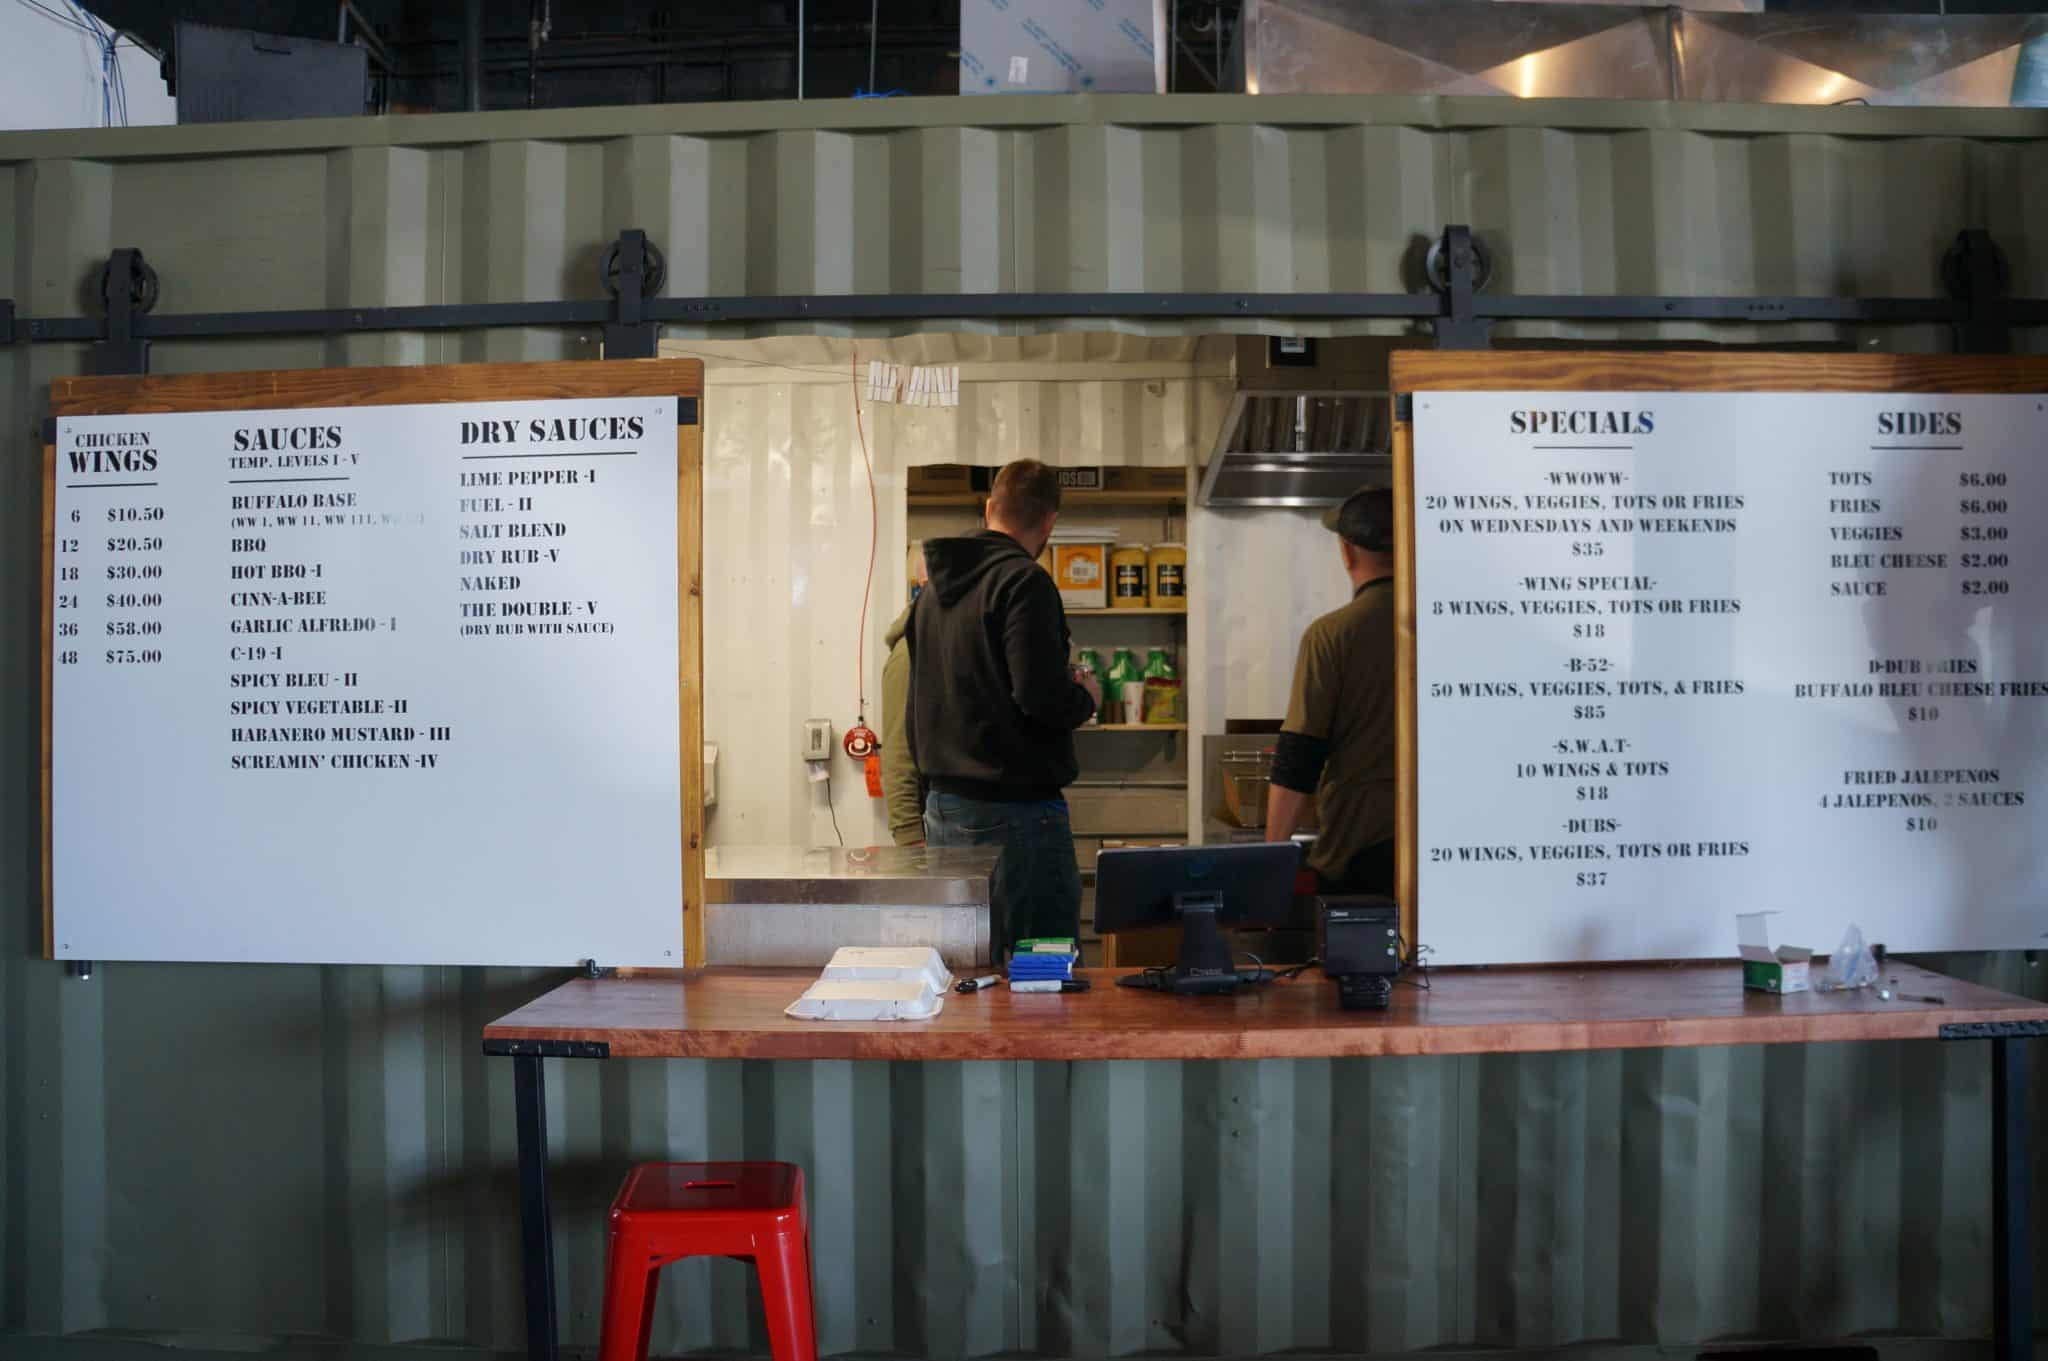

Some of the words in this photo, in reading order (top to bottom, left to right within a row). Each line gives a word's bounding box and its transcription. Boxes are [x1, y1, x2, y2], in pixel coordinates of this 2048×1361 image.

[460, 420, 520, 444] DRY
[530, 416, 644, 442] SAUCES
[1510, 411, 1654, 434] SPECIALS
[1878, 412, 1962, 435] SIDES
[75, 432, 151, 448] CHICKEN
[233, 426, 342, 451] SAUCES
[69, 449, 158, 473] WINGS
[229, 456, 273, 469] TEMP.
[278, 455, 328, 468] LEVELS
[332, 454, 338, 466] I
[350, 453, 359, 465] V
[461, 472, 502, 487] LIME
[509, 470, 578, 485] PEPPER
[1544, 471, 1628, 486] -WWOWW-
[1828, 472, 1872, 485] TOTS
[1960, 473, 2006, 487] $6.00
[232, 494, 307, 509] BUFFALO
[313, 493, 357, 507] BASE
[460, 498, 504, 512] FUEL
[519, 497, 532, 511] II
[1426, 496, 1447, 509] 20
[1612, 495, 1657, 509] TOTS
[1662, 495, 1687, 509] OR
[1693, 495, 1744, 509] FRIES
[1830, 499, 1880, 513] FRIES
[1960, 499, 2007, 513] $6.00
[71, 509, 80, 522] 6
[108, 507, 164, 522] $10.50
[232, 517, 256, 528] (WW
[277, 516, 296, 526] WW
[325, 515, 344, 525] WW
[459, 524, 503, 539] SALT
[508, 522, 566, 537] BLEND
[1439, 520, 1464, 533] ON
[1471, 519, 1591, 533] WEDNESDAYS
[1597, 519, 1634, 533] AND
[1639, 518, 1736, 533] WEEKENDS
[1830, 527, 1903, 541] VEGGIES
[1961, 527, 2008, 541] $3.00
[61, 539, 79, 552] 12
[107, 538, 162, 552] $20.50
[231, 538, 266, 553] BBQ
[1572, 542, 1603, 556] $35
[460, 550, 495, 565] DRY
[501, 550, 539, 564] RUB
[1831, 555, 1875, 568] BLEU
[1881, 554, 1948, 568] CHEESE
[1961, 554, 2008, 568] $2.00
[61, 567, 79, 580] 18
[107, 566, 162, 579] $30.00
[231, 565, 265, 579] HOT
[271, 565, 306, 579] BBQ
[459, 576, 521, 591] NAKED
[1519, 577, 1572, 591] -WING
[1578, 577, 1656, 591] SPECIAL-
[1831, 582, 1887, 596] SAUCE
[1961, 580, 2009, 594] $2.00
[59, 595, 78, 608] 24
[106, 594, 162, 607] $40.00
[231, 592, 326, 606] CINN-A-BEE
[460, 602, 496, 617] THE
[502, 601, 572, 616] DOUBLE
[588, 601, 598, 614] V
[1433, 602, 1442, 615] 8
[1610, 600, 1654, 614] TOTS
[1659, 600, 1683, 614] OR
[1689, 600, 1741, 613] FRIES
[59, 623, 78, 637] 36
[106, 622, 162, 636] $58.00
[231, 620, 293, 633] GARLIC
[298, 618, 375, 632] ALFREDO
[390, 617, 395, 631] I
[460, 625, 491, 636] (DRY
[496, 624, 523, 635] RUB
[527, 624, 562, 635] WITH
[566, 623, 614, 635] SAUCE)
[1573, 624, 1605, 638] $18
[58, 651, 78, 664] 48
[106, 650, 162, 664] $75.00
[231, 647, 266, 660] C-19
[1870, 660, 1920, 674] D-DUB
[231, 673, 280, 687] SPICY
[286, 673, 329, 687] BLEU
[344, 673, 358, 686] II
[1431, 683, 1452, 697] 50
[1674, 681, 1686, 695] &
[1692, 680, 1744, 694] FRIES
[1795, 684, 1873, 697] BUFFALO
[1879, 683, 1921, 697] BLEU
[1928, 683, 1994, 697] CHEESE
[2000, 683, 2048, 696] FRIES
[231, 701, 280, 714] SPICY
[286, 700, 384, 714] VEGETABLE
[1574, 705, 1605, 719] $85
[1908, 707, 1939, 721] $10
[232, 728, 325, 742] HABANERO
[331, 727, 414, 741] MUSTARD
[430, 727, 450, 740] III
[331, 754, 410, 768] CHICKEN
[1516, 764, 1536, 777] 10
[1543, 763, 1600, 777] WINGS
[1606, 762, 1618, 777] &
[1624, 762, 1669, 775] TOTS
[1844, 770, 1896, 784] FRIED
[1901, 770, 1999, 784] JALEPENOS
[1576, 787, 1608, 800] $18
[1820, 795, 1827, 808] 4
[1958, 792, 2024, 806] SAUCES
[1906, 817, 1937, 831] $10
[1431, 848, 1452, 861] 20
[1618, 844, 1661, 858] TOTS
[1667, 843, 1691, 857] OR
[1698, 842, 1749, 856] FRIES
[1576, 873, 1607, 886] $37
